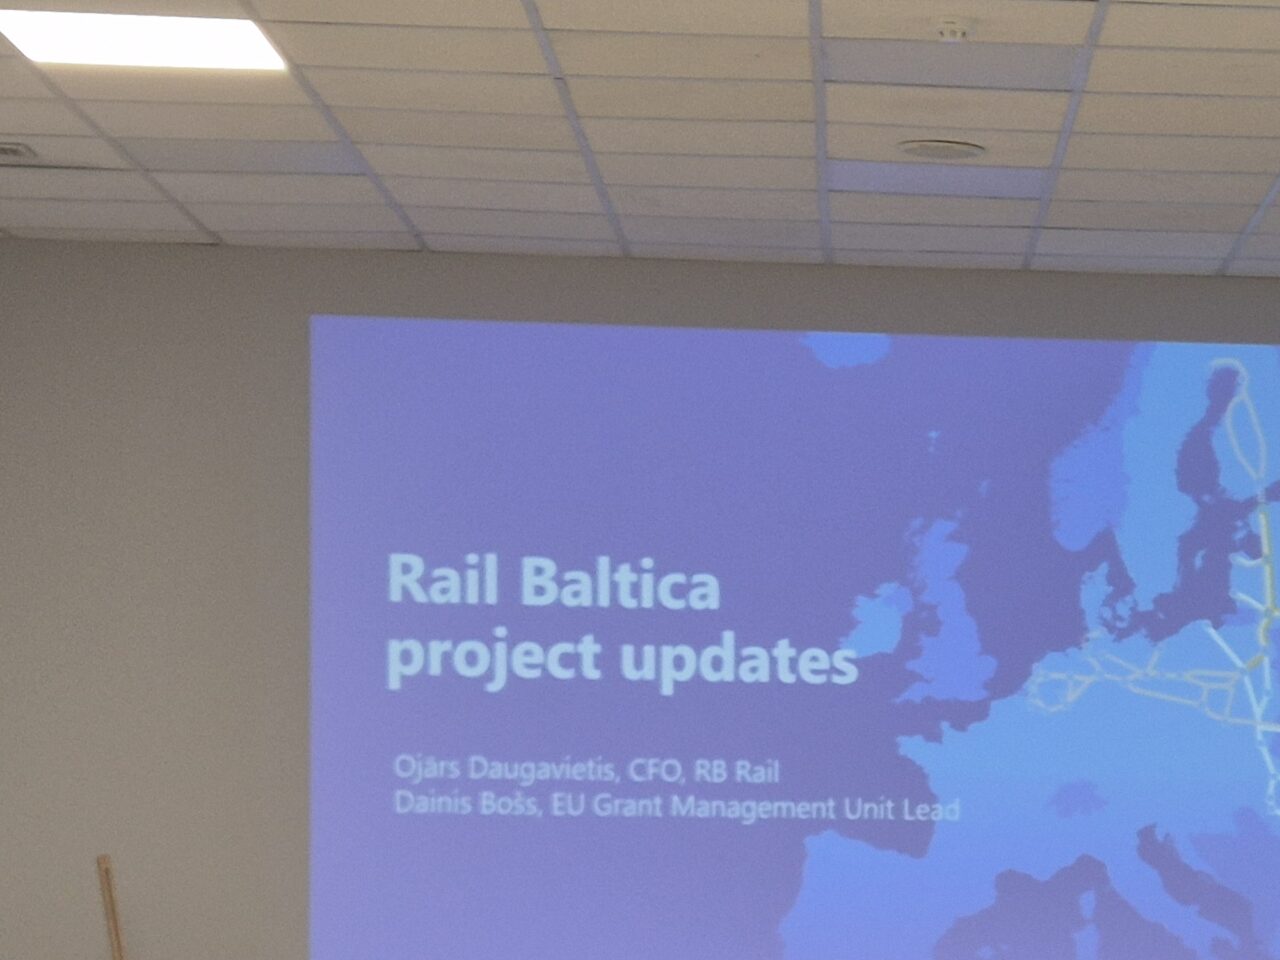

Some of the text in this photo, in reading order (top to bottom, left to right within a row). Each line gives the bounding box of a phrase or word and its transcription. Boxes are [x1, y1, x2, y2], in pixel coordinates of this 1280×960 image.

[388, 553, 721, 610] Rail Baltica
[385, 626, 859, 696] project updates
[394, 753, 780, 786] Ojārs Daugavietis, CFO, RB Rail
[394, 788, 960, 824] Dainis Bošs, EU Grant Management Unit Lead
